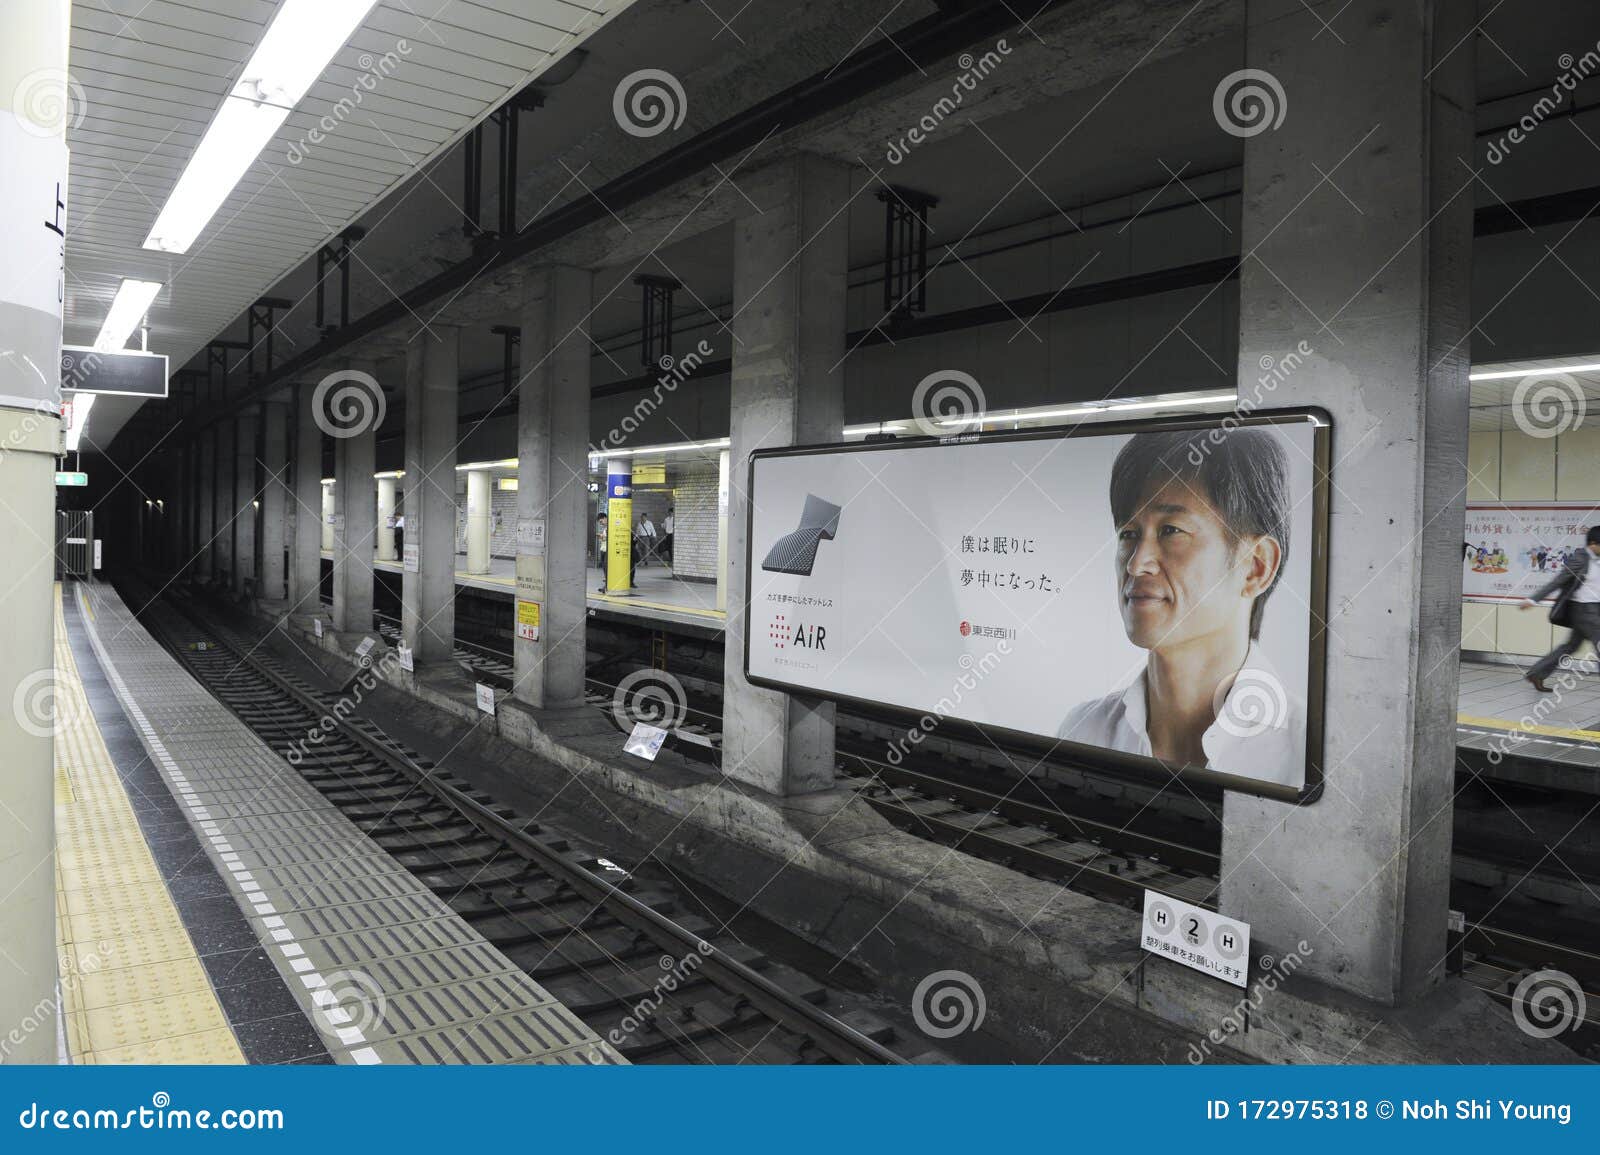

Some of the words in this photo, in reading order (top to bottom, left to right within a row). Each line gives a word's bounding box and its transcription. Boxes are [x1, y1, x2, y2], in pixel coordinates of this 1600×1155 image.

[961, 535, 1035, 555] 僕は眠りに
[960, 569, 1061, 594] 夢中になった。
[972, 625, 1016, 640] 東京西川
[1157, 911, 1166, 924] H
[1188, 918, 1199, 937] 2
[1223, 934, 1233, 949] H
[1146, 935, 1242, 979] 整列乗車をお願いします
